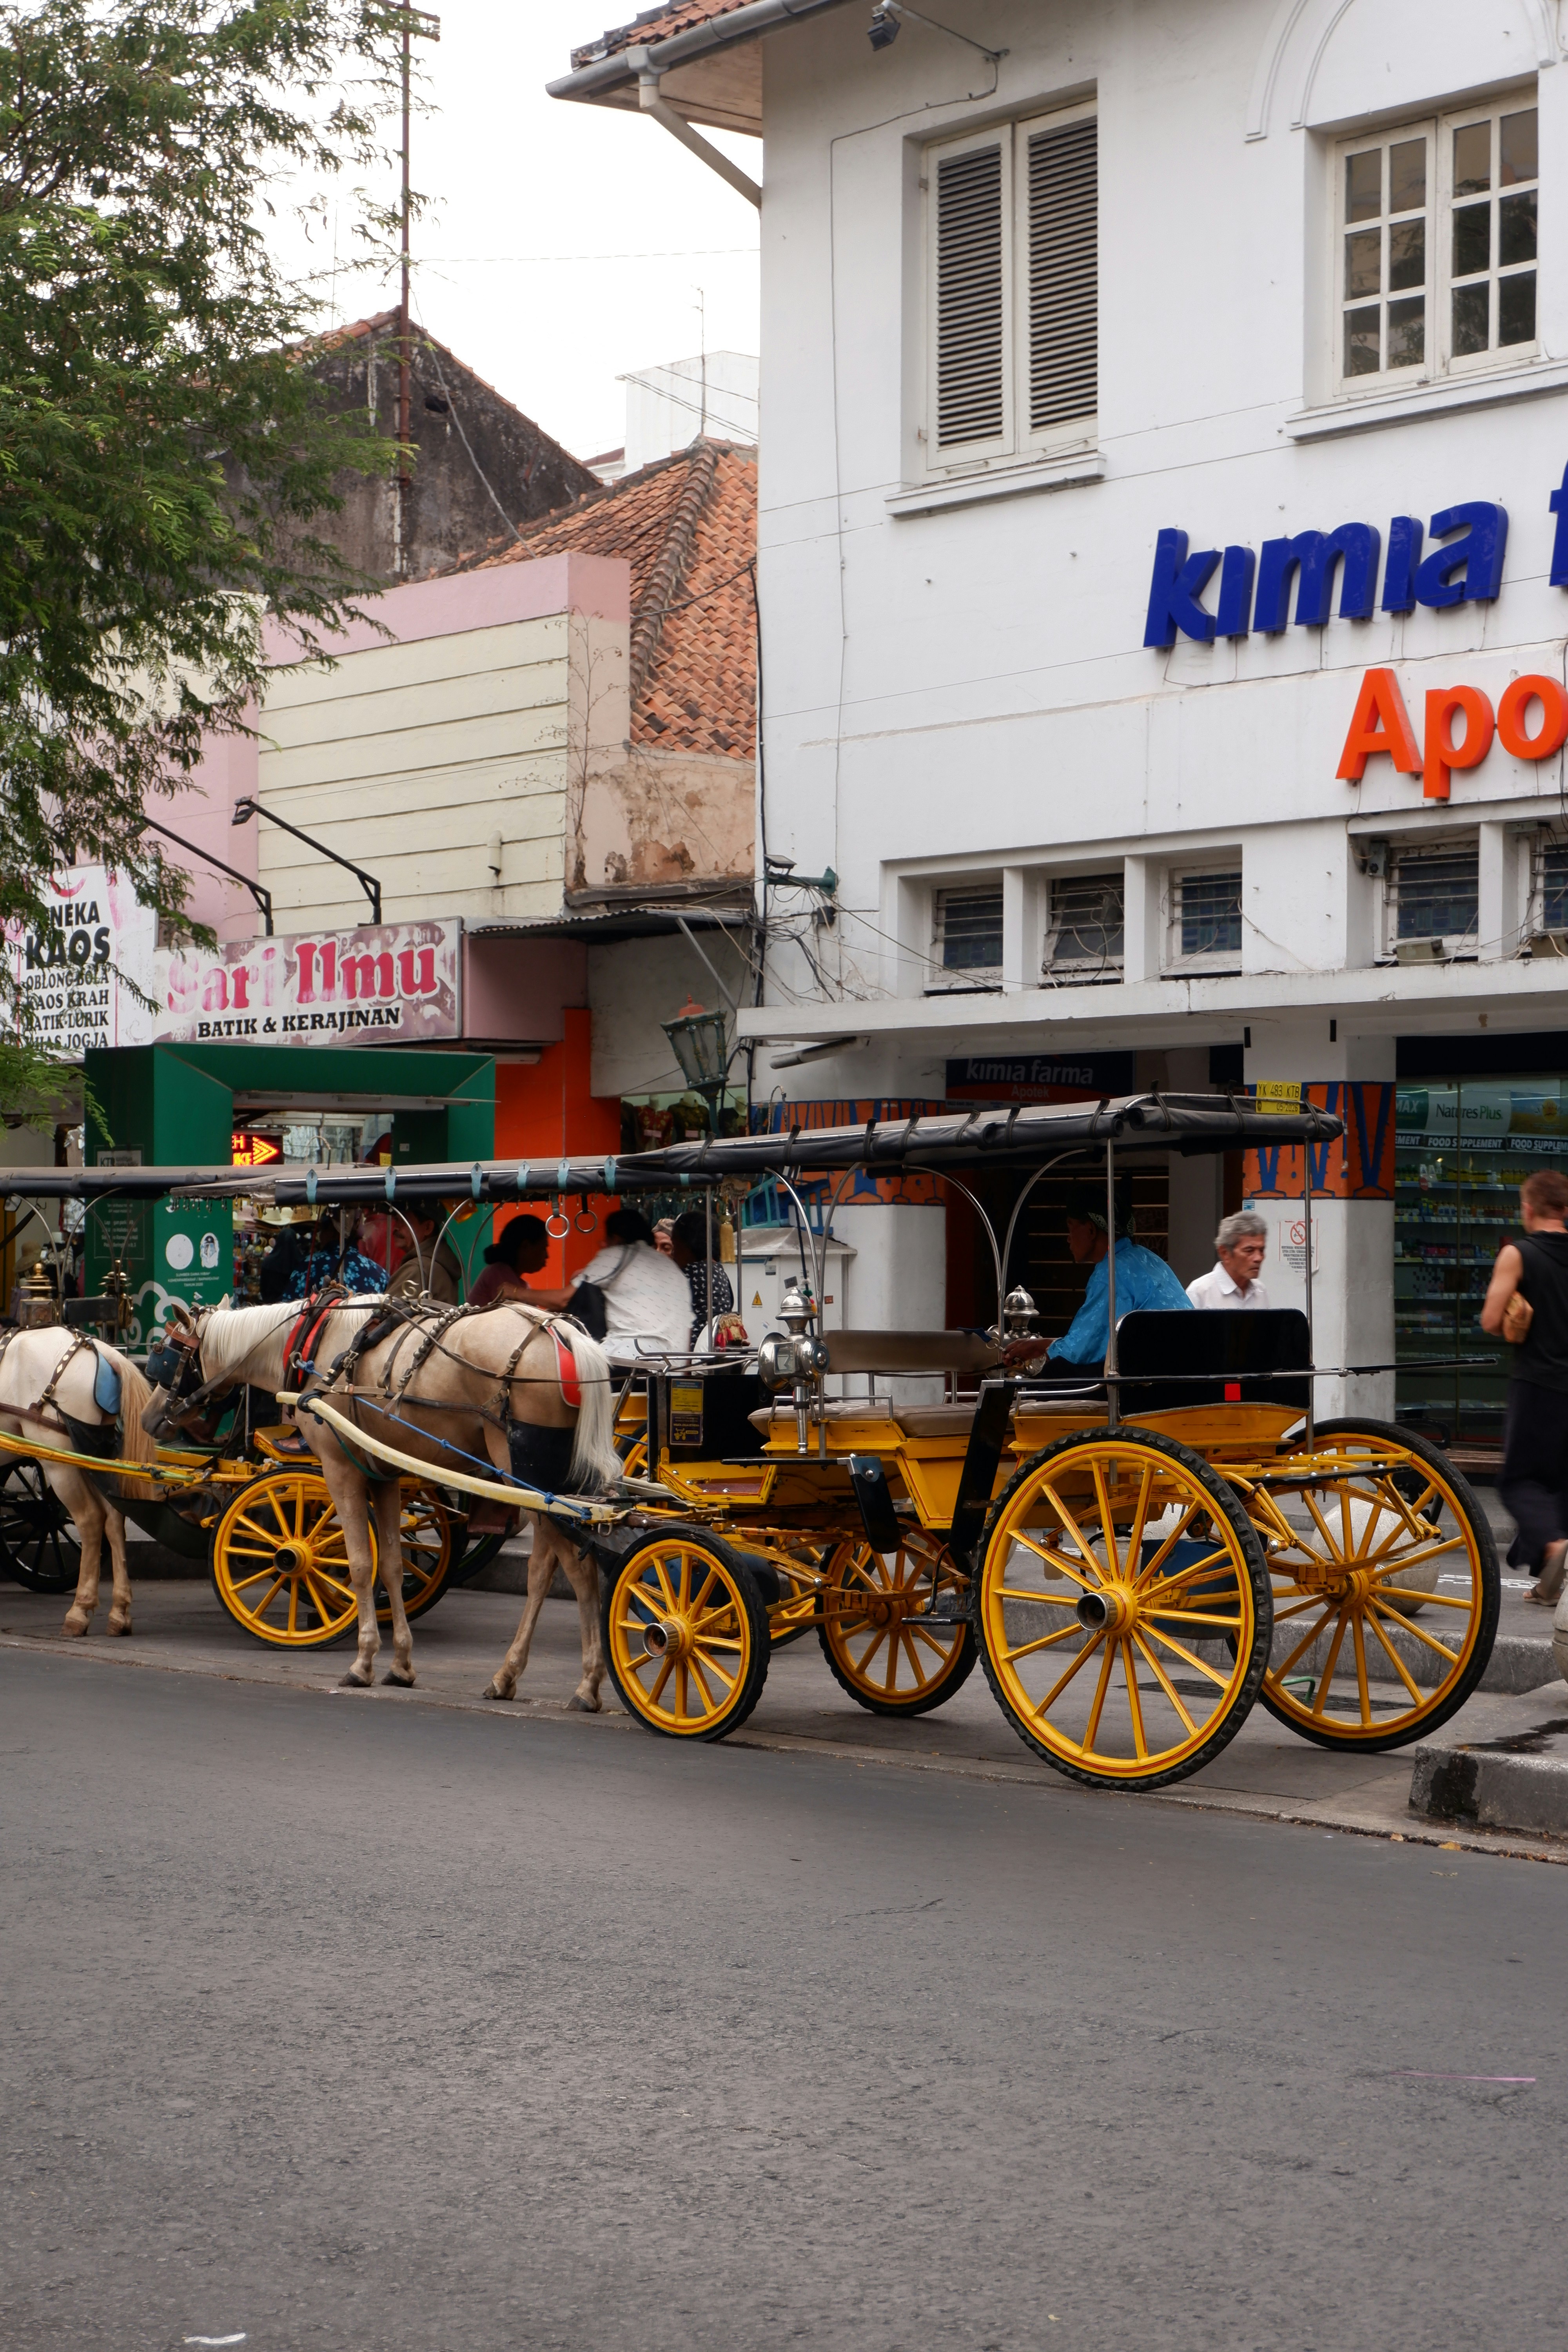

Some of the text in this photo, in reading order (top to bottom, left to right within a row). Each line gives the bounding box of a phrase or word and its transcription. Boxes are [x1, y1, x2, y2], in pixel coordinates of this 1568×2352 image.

[1336, 668, 1568, 799] Apo
[48, 900, 100, 928] NEKA
[26, 926, 110, 970] KAOS
[167, 941, 437, 1014] Sari Ilmu
[198, 1007, 400, 1038] BATIK & KERAJINAN
[64, 1031, 108, 1049] JOGJA
[1030, 1059, 1094, 1084] farma
[1011, 1084, 1049, 1099] Apotek
[1258, 1083, 1300, 1097] YK 483 KTB
[1428, 1137, 1451, 1147] FOOD
[1510, 1138, 1532, 1149] FOOD
